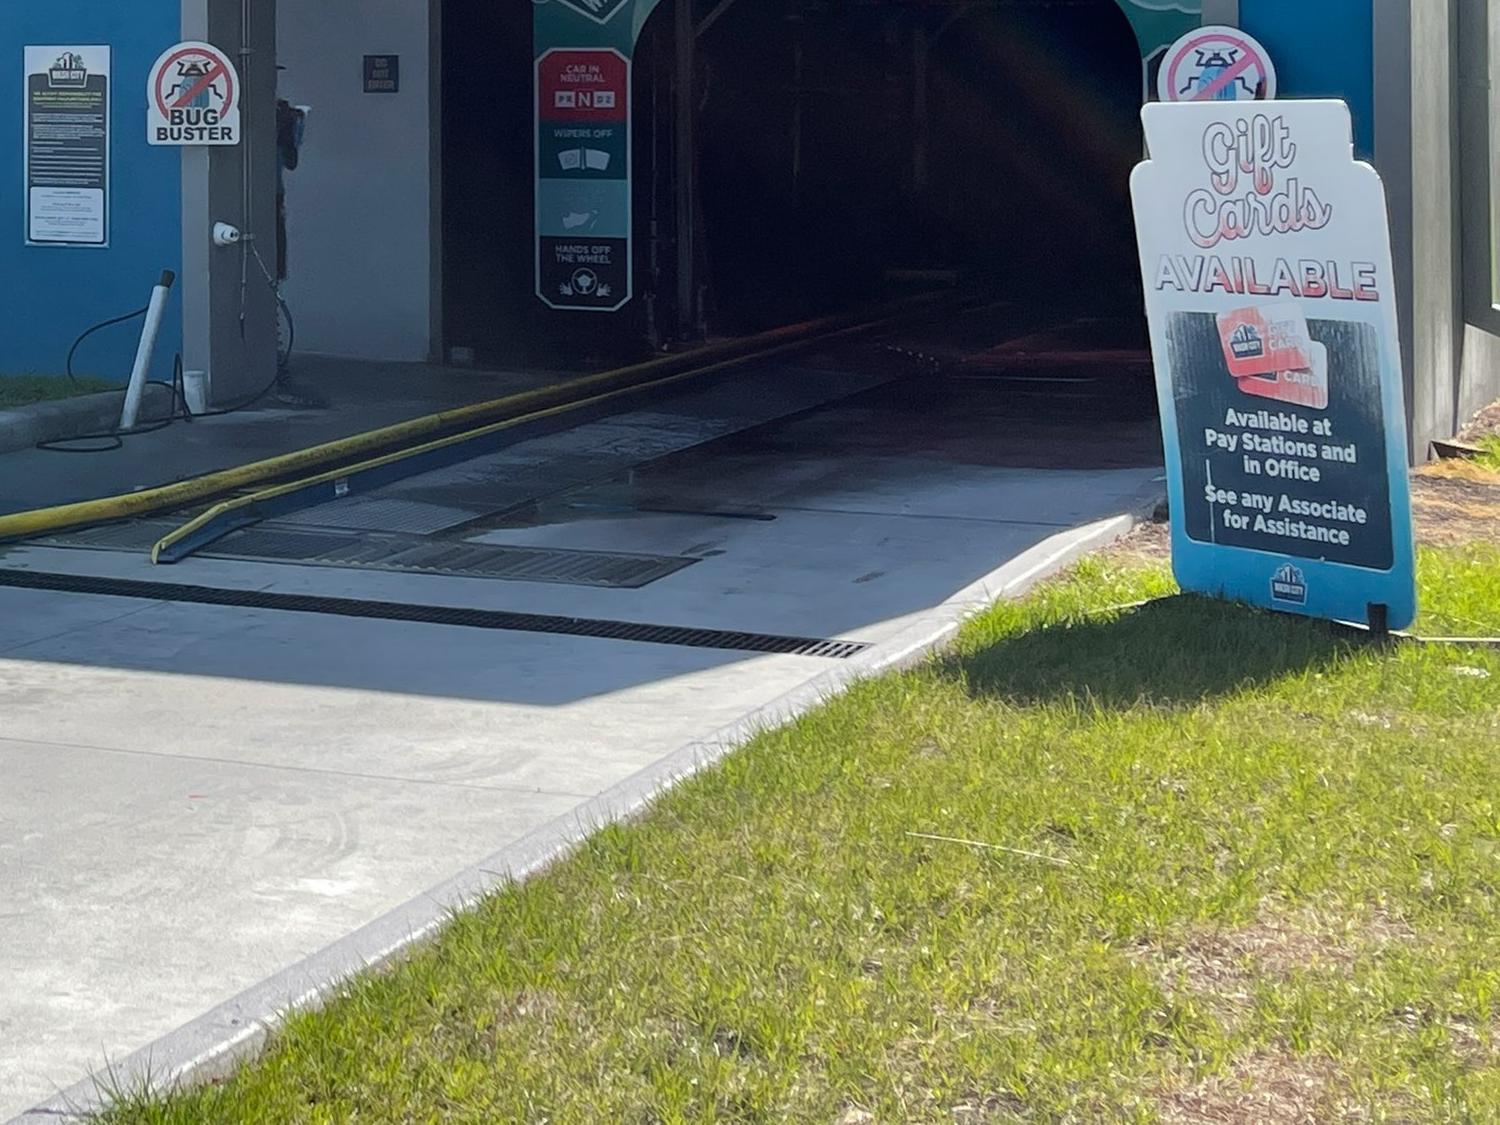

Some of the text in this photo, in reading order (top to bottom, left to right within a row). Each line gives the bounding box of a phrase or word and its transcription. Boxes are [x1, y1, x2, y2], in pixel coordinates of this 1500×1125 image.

[560, 74, 606, 83] NEUTRAL
[566, 65, 599, 74] CAR IN
[578, 91, 592, 107] N
[169, 109, 219, 126] BUG
[156, 127, 233, 141] BUSTER
[554, 129, 613, 138] WIPERS OFF
[1202, 114, 1296, 195] Gift
[1183, 177, 1332, 249] Cards
[555, 245, 612, 255] HANDS OFF
[556, 254, 612, 264] THE WHEEL
[1155, 254, 1380, 302] AVAILABLE
[1225, 408, 1332, 436] Available at
[1205, 428, 1357, 463] Pay Stations and
[1244, 455, 1321, 482] in Office
[1205, 485, 1367, 524] See any Associate
[1223, 509, 1350, 546] for Assistance
